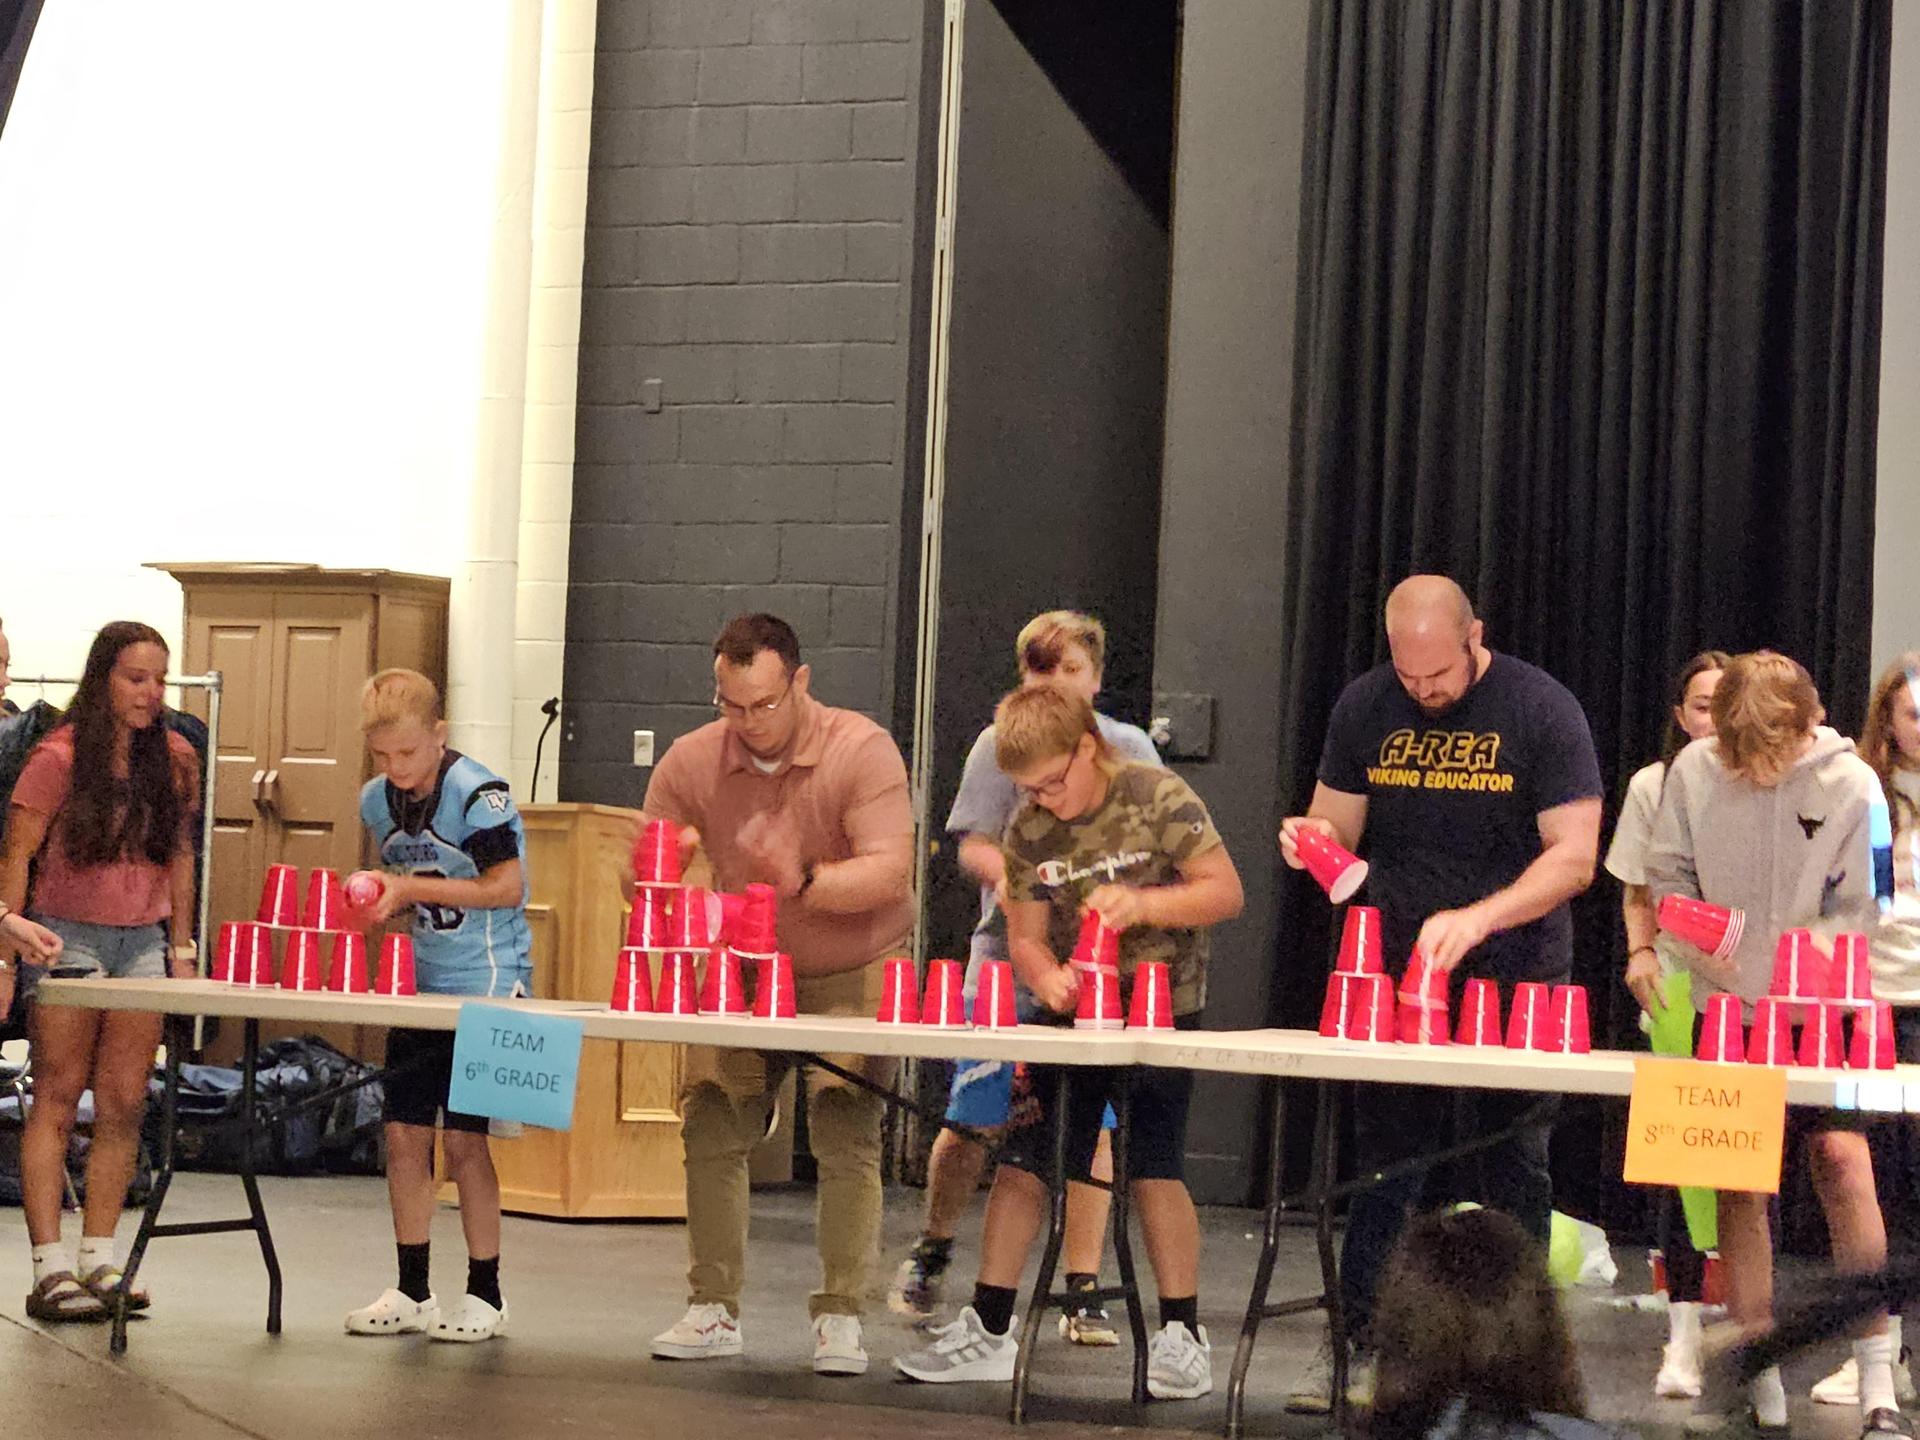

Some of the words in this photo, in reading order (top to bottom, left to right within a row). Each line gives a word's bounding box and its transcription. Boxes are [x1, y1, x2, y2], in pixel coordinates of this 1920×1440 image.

[1380, 728, 1500, 772] A-REA
[1367, 767, 1421, 788] VIKING
[1424, 771, 1514, 792] EDUCATOR
[1037, 851, 1151, 887] Champion
[490, 1027, 545, 1053] TEAM
[465, 1060, 489, 1081] 6th
[494, 1067, 562, 1094] GRADE
[1675, 1085, 1742, 1109] TEAM
[1644, 1123, 1675, 1145] 8th
[1683, 1126, 1763, 1151] GRADE
